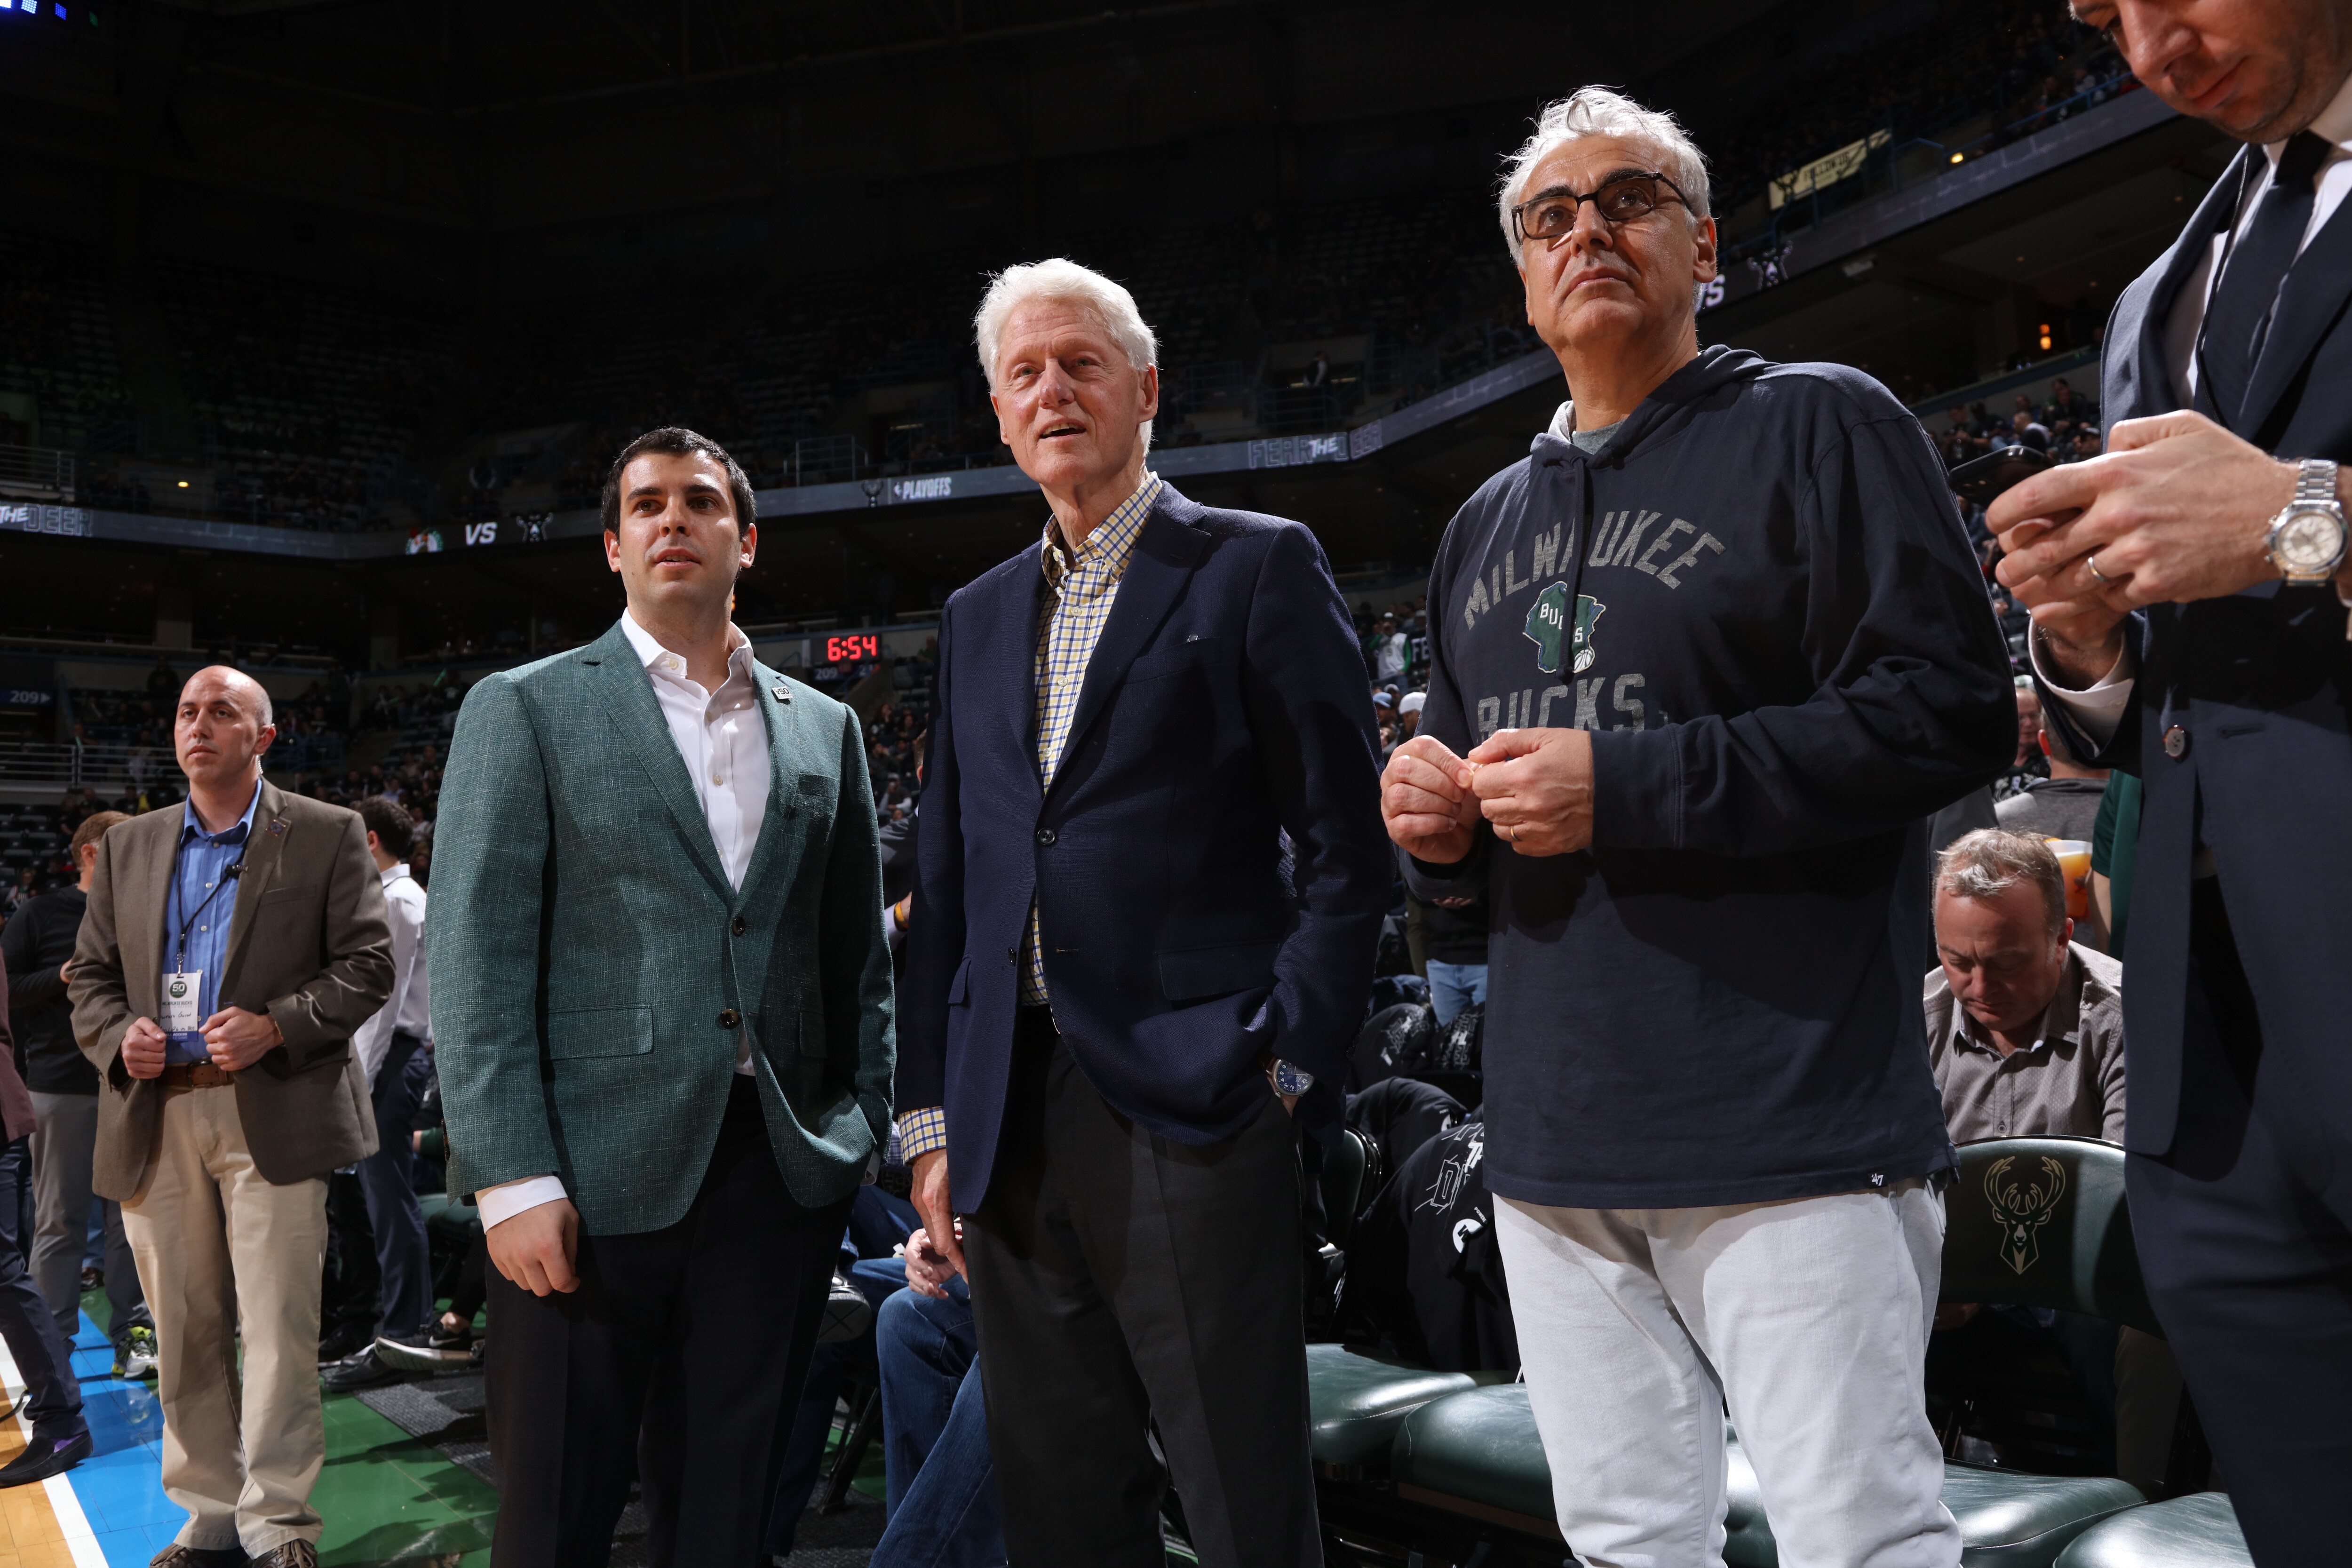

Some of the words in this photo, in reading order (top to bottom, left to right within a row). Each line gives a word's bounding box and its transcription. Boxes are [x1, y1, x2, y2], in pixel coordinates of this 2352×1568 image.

[1804, 160, 1837, 181] FLLOW
[1308, 437, 1339, 459] THE
[902, 472, 952, 500] PLAYOFFS
[0, 505, 30, 524] THE
[24, 502, 94, 538] DEER
[465, 522, 497, 546] VS
[1540, 603, 1583, 643] BUS
[827, 636, 877, 661] 6:54
[814, 667, 838, 680] 209
[10, 690, 39, 704] 209
[1477, 673, 1645, 741] BUCKS
[172, 983, 185, 992] 50
